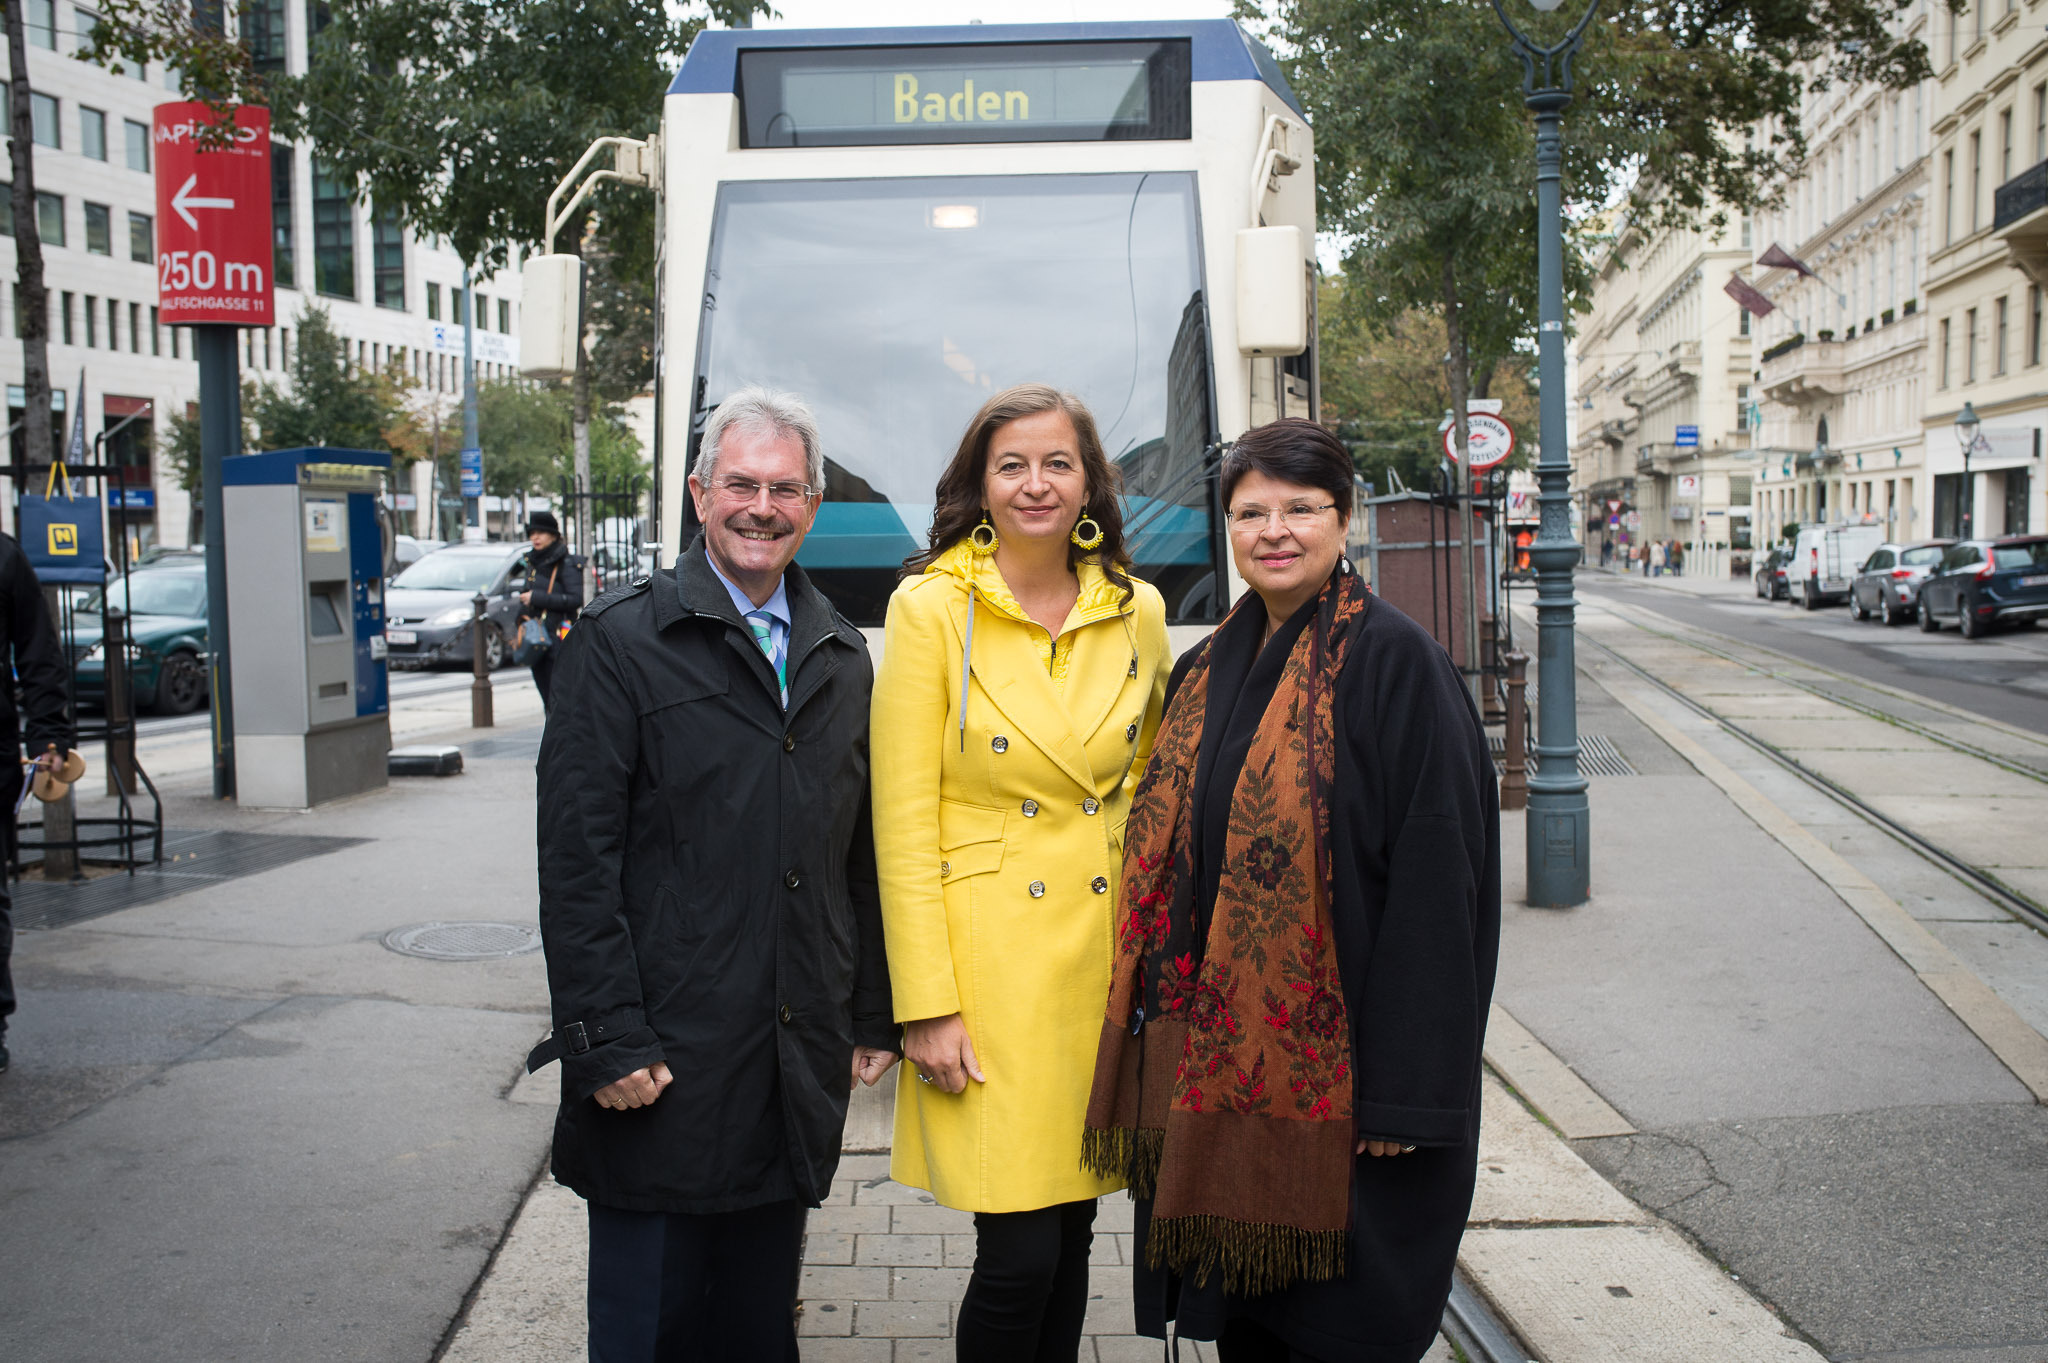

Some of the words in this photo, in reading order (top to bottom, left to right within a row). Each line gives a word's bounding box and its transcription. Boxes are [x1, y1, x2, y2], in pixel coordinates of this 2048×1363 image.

[894, 73, 1029, 123] Baden
[160, 250, 216, 292] 250
[224, 261, 263, 293] m
[253, 298, 264, 312] 11
